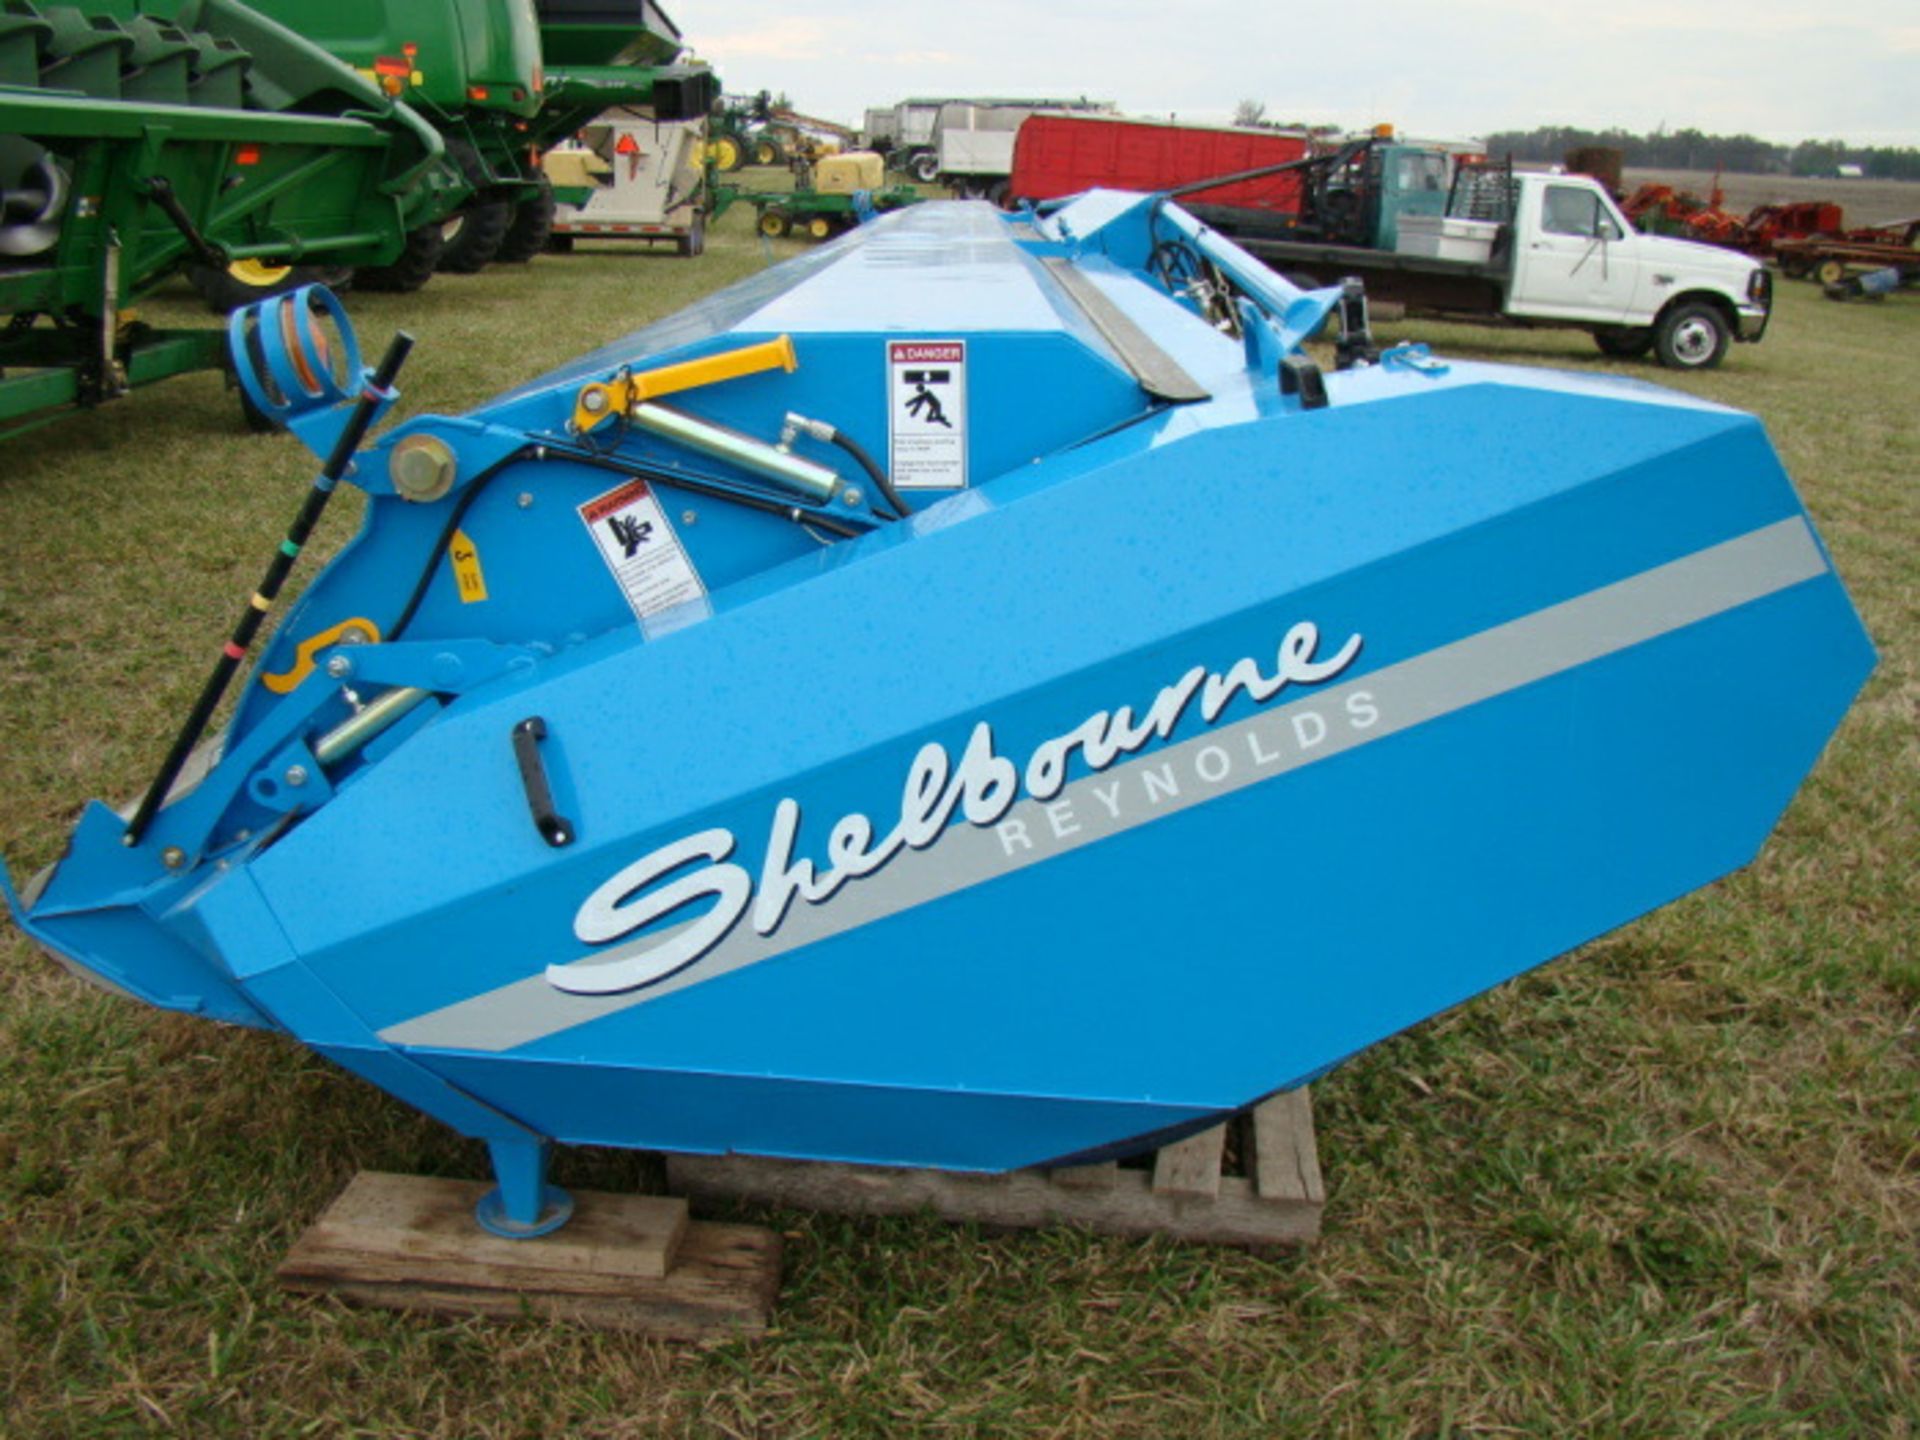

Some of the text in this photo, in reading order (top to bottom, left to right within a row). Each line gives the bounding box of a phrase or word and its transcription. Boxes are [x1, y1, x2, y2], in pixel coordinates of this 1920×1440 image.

[907, 348, 961, 360] DANGER
[545, 620, 1363, 995] Shelbourne
[995, 690, 1380, 857] REYNOLDS
